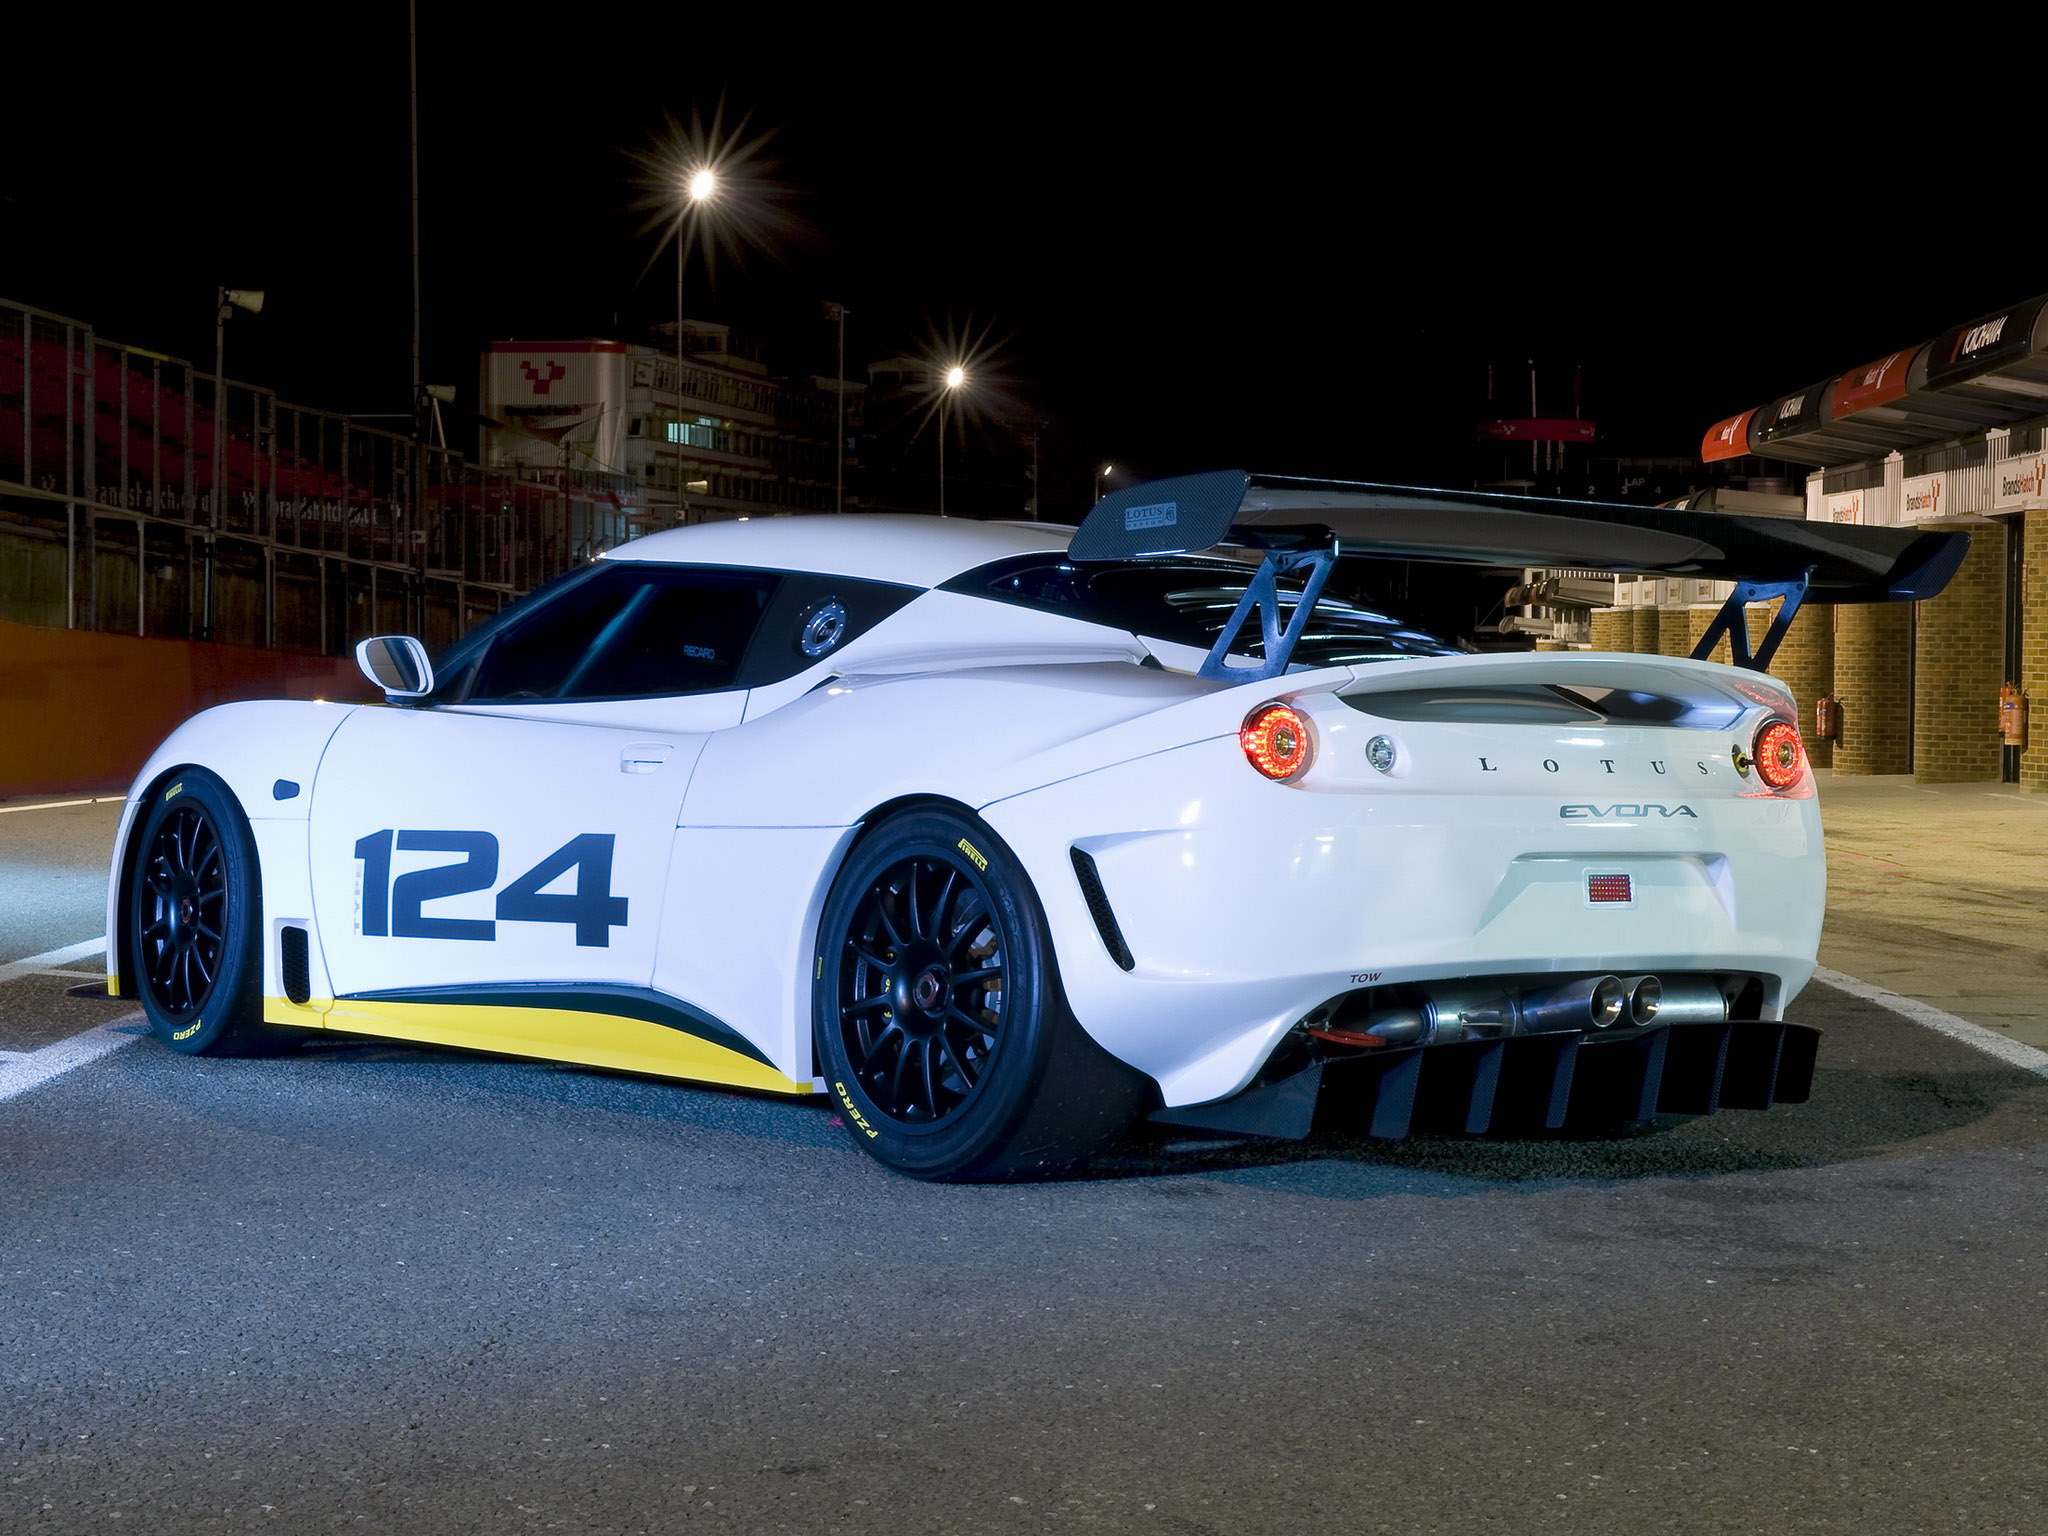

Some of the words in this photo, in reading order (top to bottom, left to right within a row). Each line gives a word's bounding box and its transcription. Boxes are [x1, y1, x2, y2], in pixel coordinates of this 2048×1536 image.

[1126, 507, 1163, 520] LOTUS
[684, 645, 715, 660] RECARO
[1478, 757, 1709, 776] LOTUS
[1559, 804, 1699, 819] EVORA
[958, 838, 988, 872] PIRELLI
[354, 829, 629, 948] 124
[1350, 972, 1383, 984] TOW
